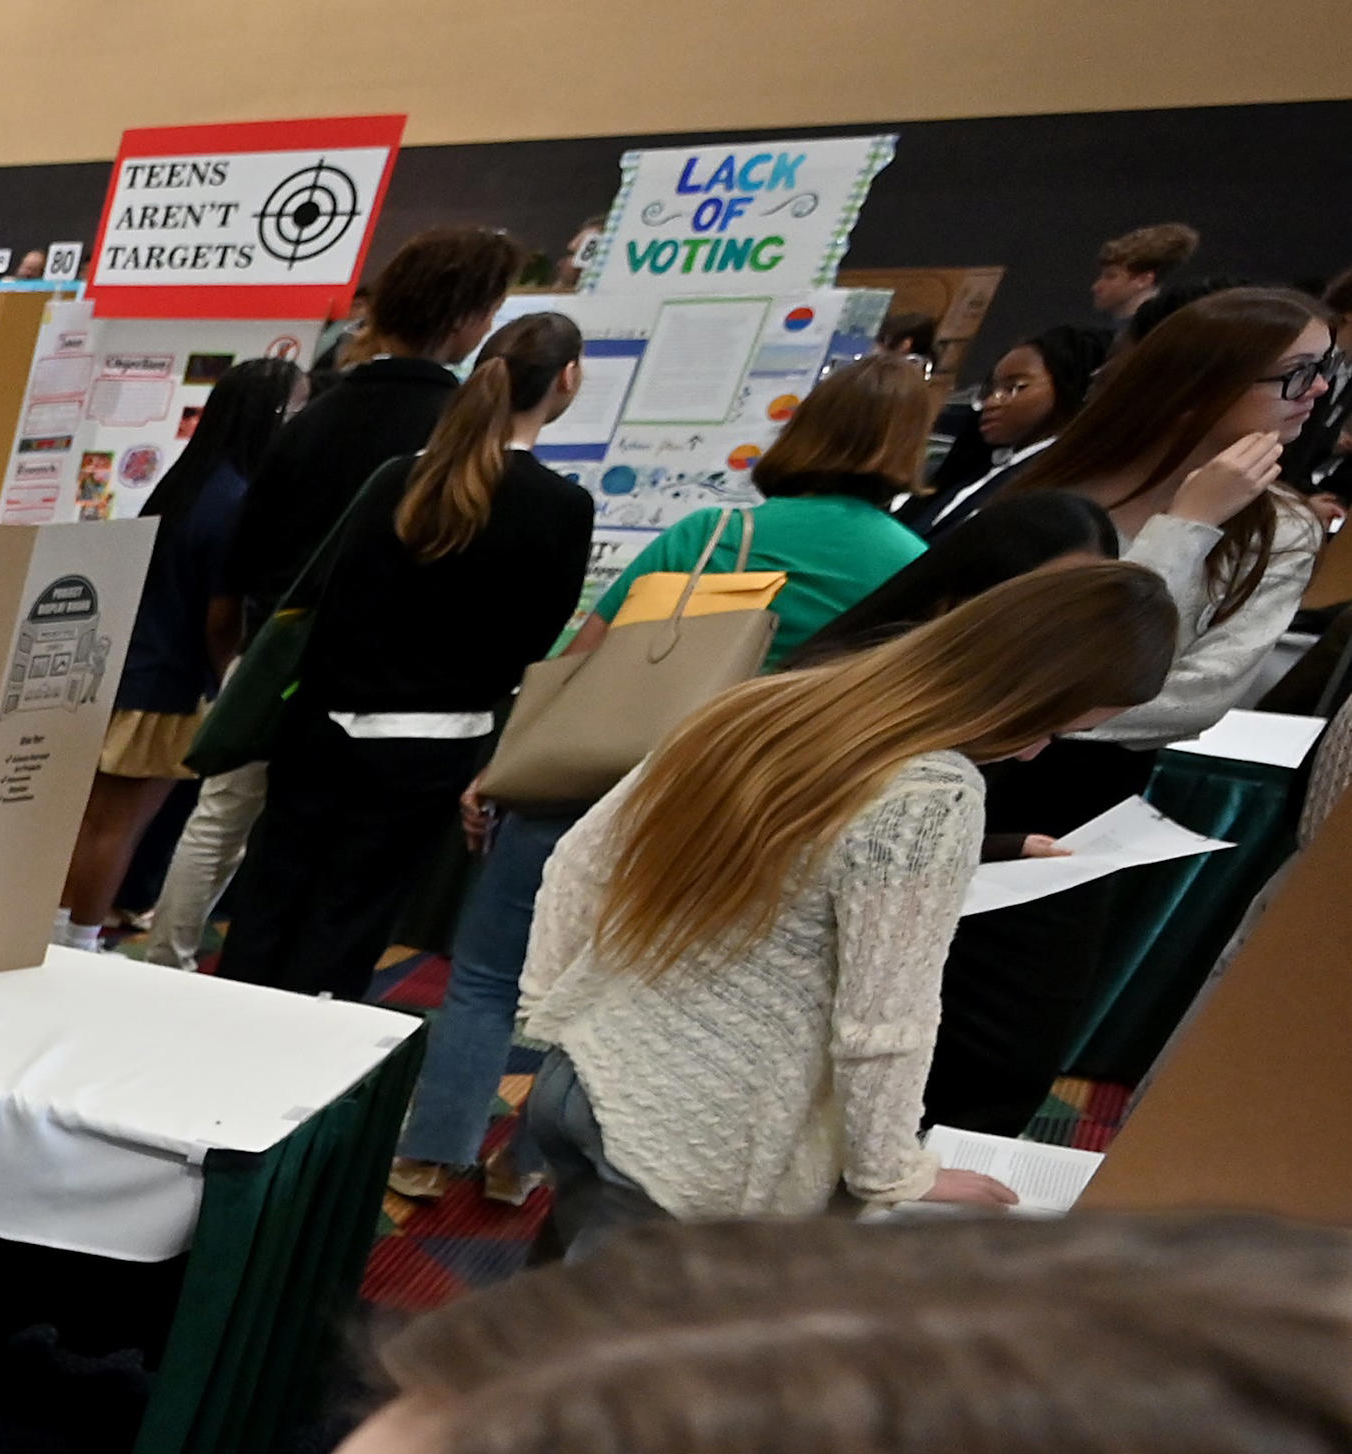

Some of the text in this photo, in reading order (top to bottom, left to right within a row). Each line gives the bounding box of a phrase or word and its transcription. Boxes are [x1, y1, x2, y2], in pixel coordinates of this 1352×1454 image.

[125, 160, 231, 190] TEENS
[675, 152, 808, 195] LACK
[115, 202, 240, 231] AREN'T
[692, 196, 754, 233] OF
[50, 250, 75, 273] 80
[106, 244, 257, 271] TARGETS
[626, 234, 786, 274] VOTING
